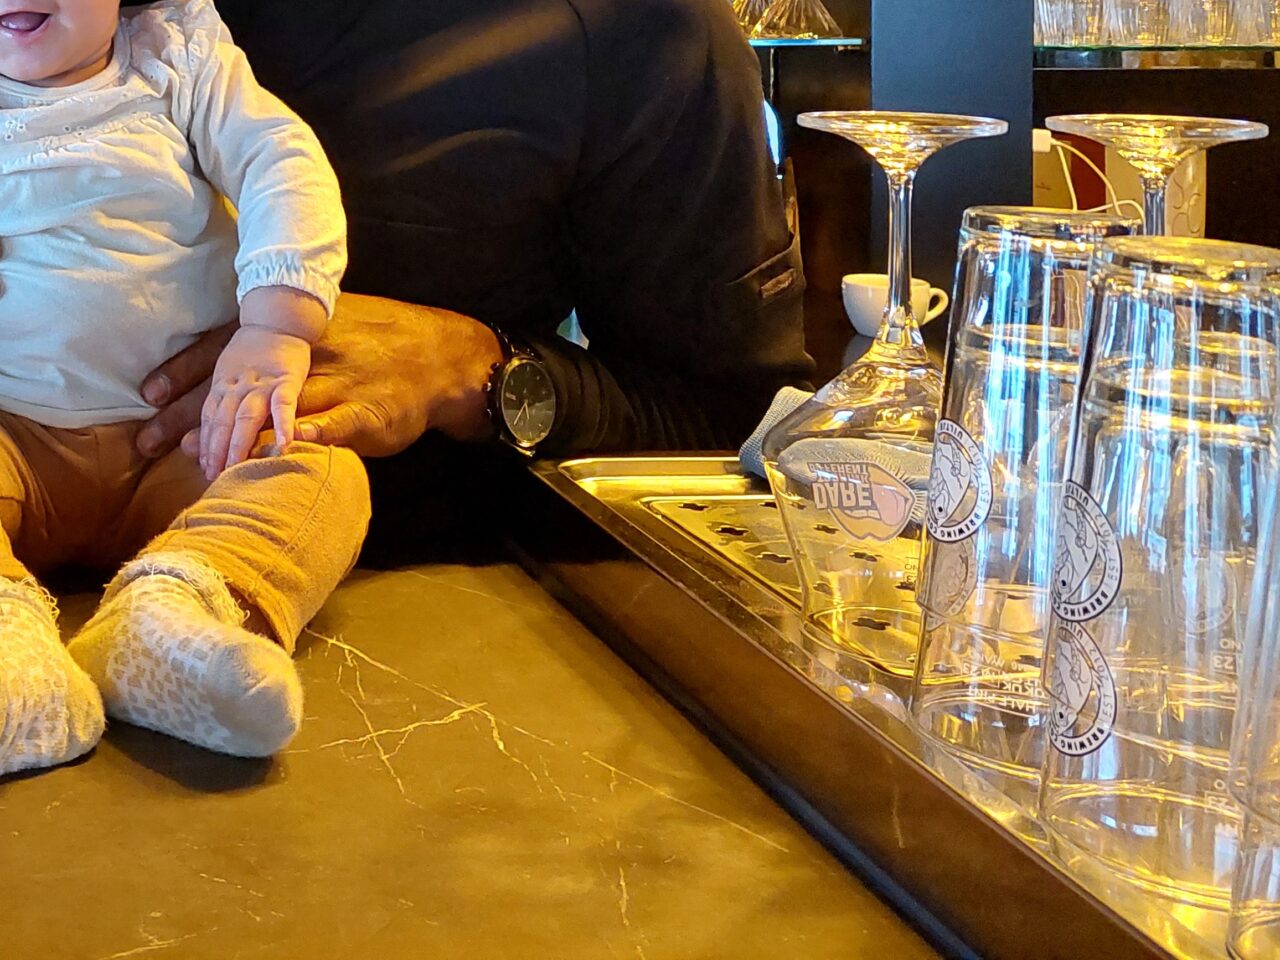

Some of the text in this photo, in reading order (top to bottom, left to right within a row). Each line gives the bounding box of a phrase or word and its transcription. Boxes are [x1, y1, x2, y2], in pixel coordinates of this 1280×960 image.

[940, 512, 982, 538] BREWING
[1063, 590, 1109, 617] BREWING
[1060, 727, 1105, 752] BREWING
